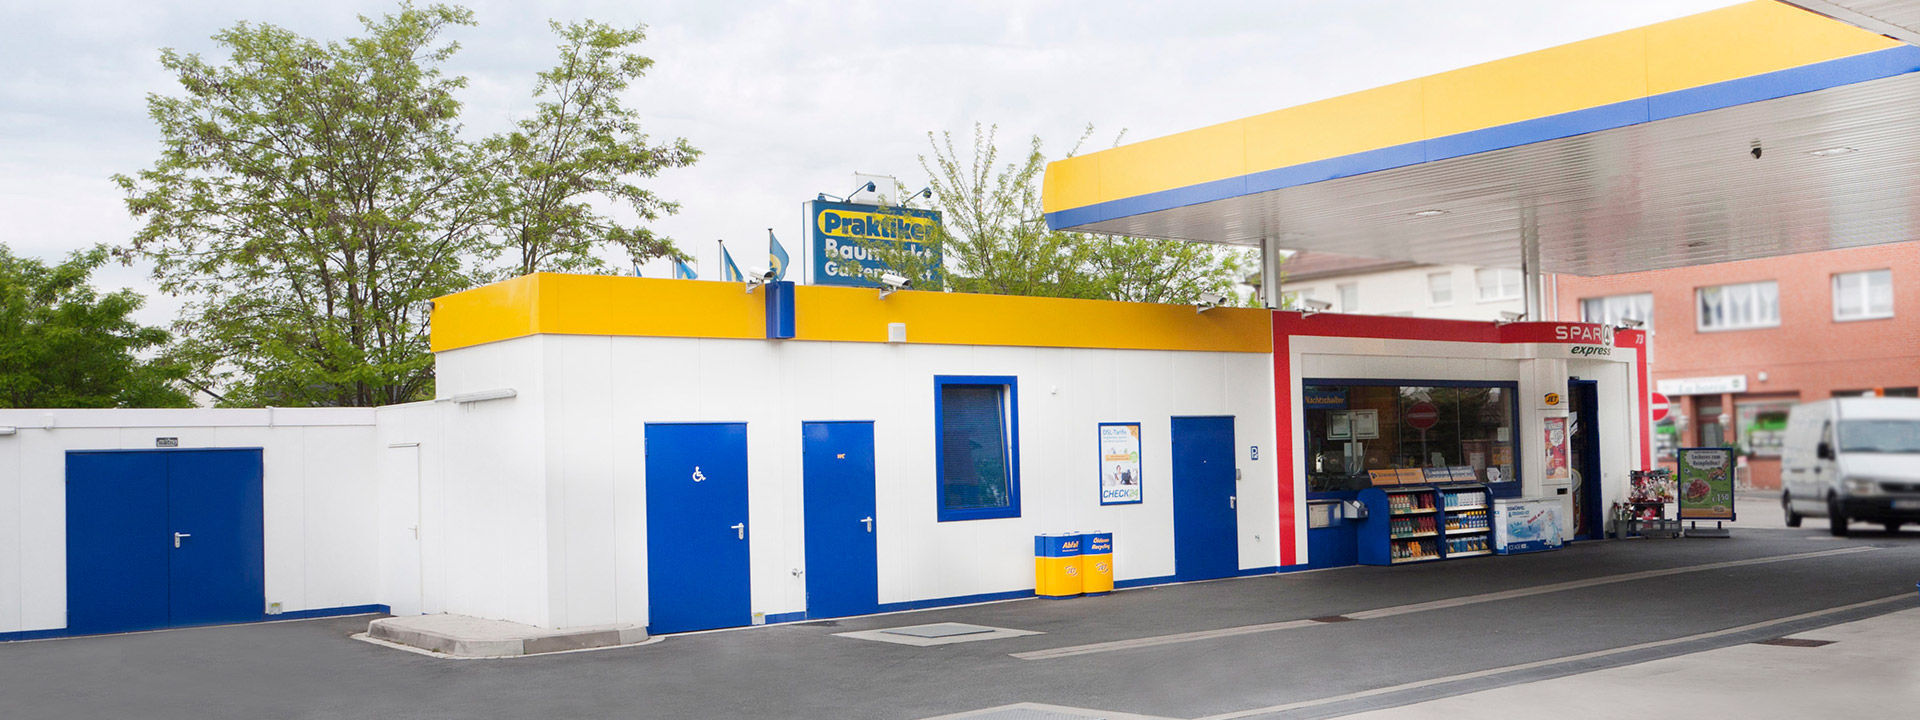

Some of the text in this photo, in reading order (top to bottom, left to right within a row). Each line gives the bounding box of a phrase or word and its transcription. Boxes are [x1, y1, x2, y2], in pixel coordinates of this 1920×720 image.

[825, 238, 932, 261] Baumkt
[1555, 326, 1601, 340] SPAR
[1635, 333, 1644, 345] 73
[1571, 346, 1611, 356] express
[1062, 540, 1079, 549] Abfall
